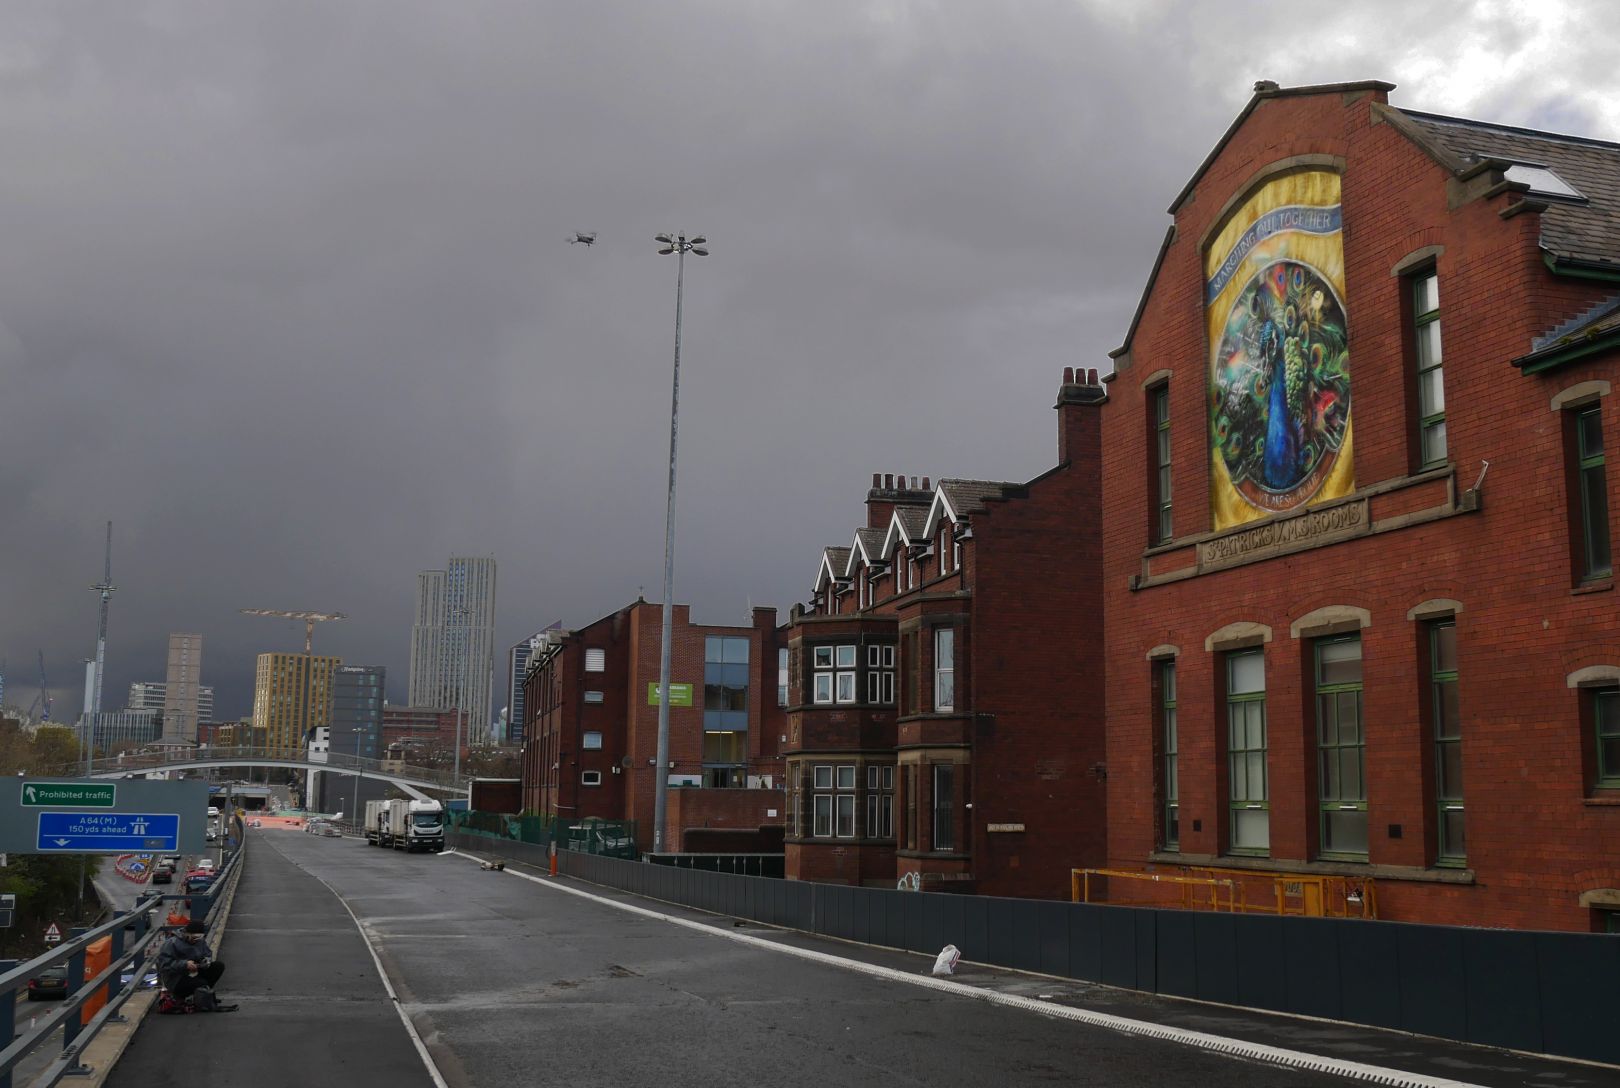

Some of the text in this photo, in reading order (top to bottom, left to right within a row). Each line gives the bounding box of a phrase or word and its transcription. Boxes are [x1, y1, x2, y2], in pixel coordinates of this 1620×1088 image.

[1213, 231, 1256, 291] MARCHING
[1279, 211, 1331, 230] TOGETHER
[1310, 504, 1362, 537] ROOMS
[39, 790, 111, 799] Prohibited traffic
[69, 825, 84, 833] 150
[85, 826, 99, 834] yds
